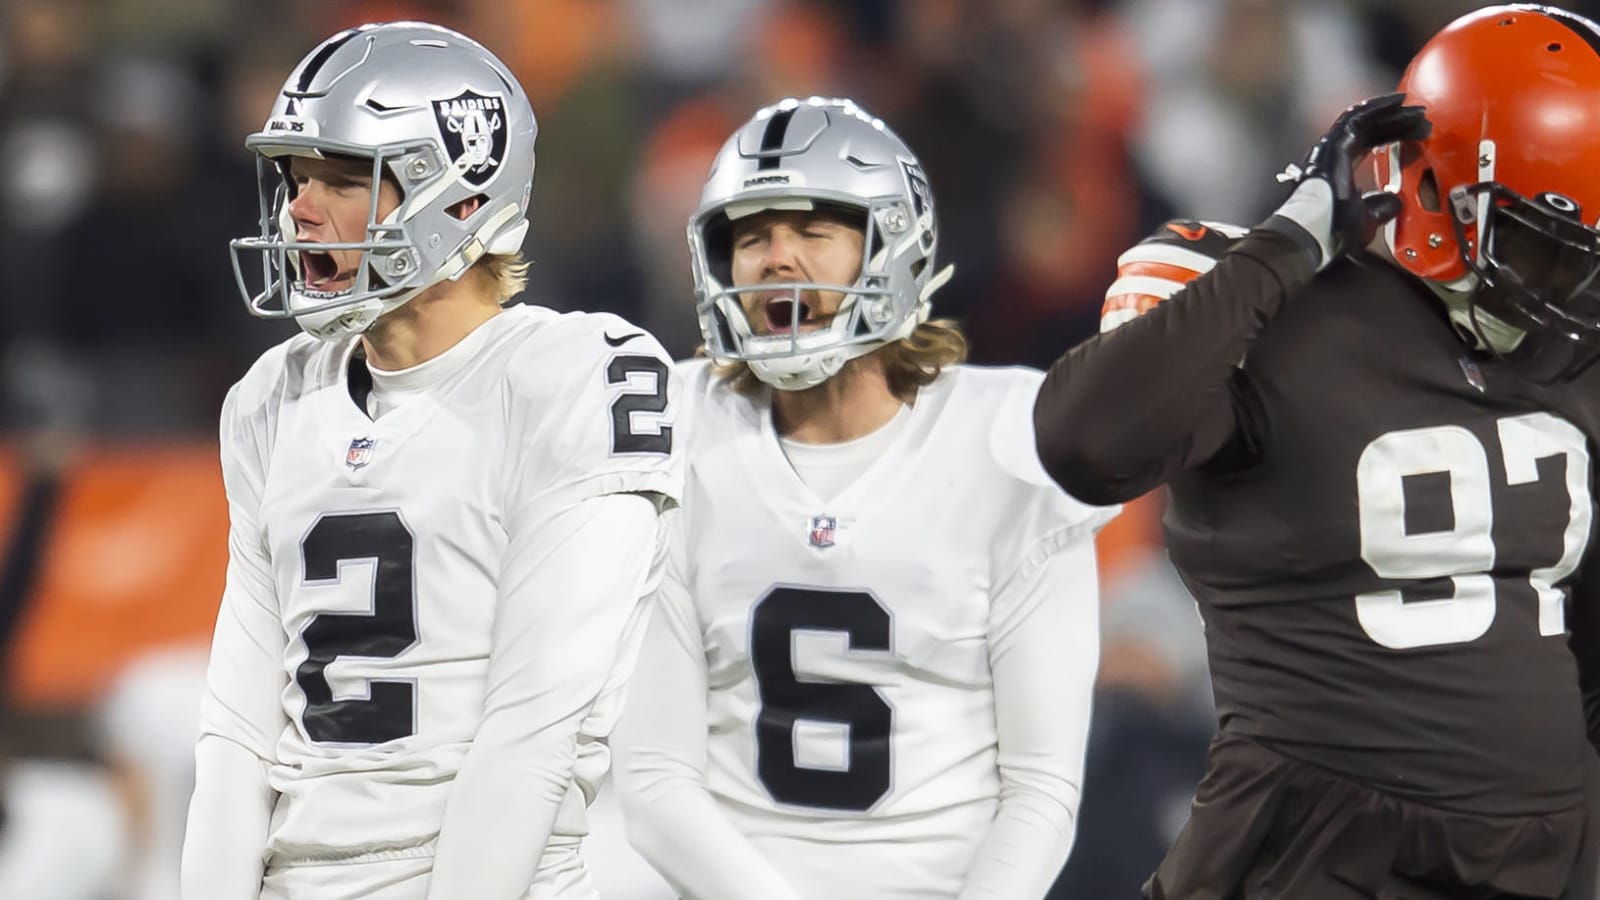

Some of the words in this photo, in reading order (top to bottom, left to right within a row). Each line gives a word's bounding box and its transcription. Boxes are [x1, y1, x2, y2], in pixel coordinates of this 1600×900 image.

[439, 98, 500, 117] RAIDERS
[603, 352, 673, 458] 2
[295, 507, 422, 749] 2
[1355, 411, 1593, 650] 97
[746, 582, 896, 816] 6
